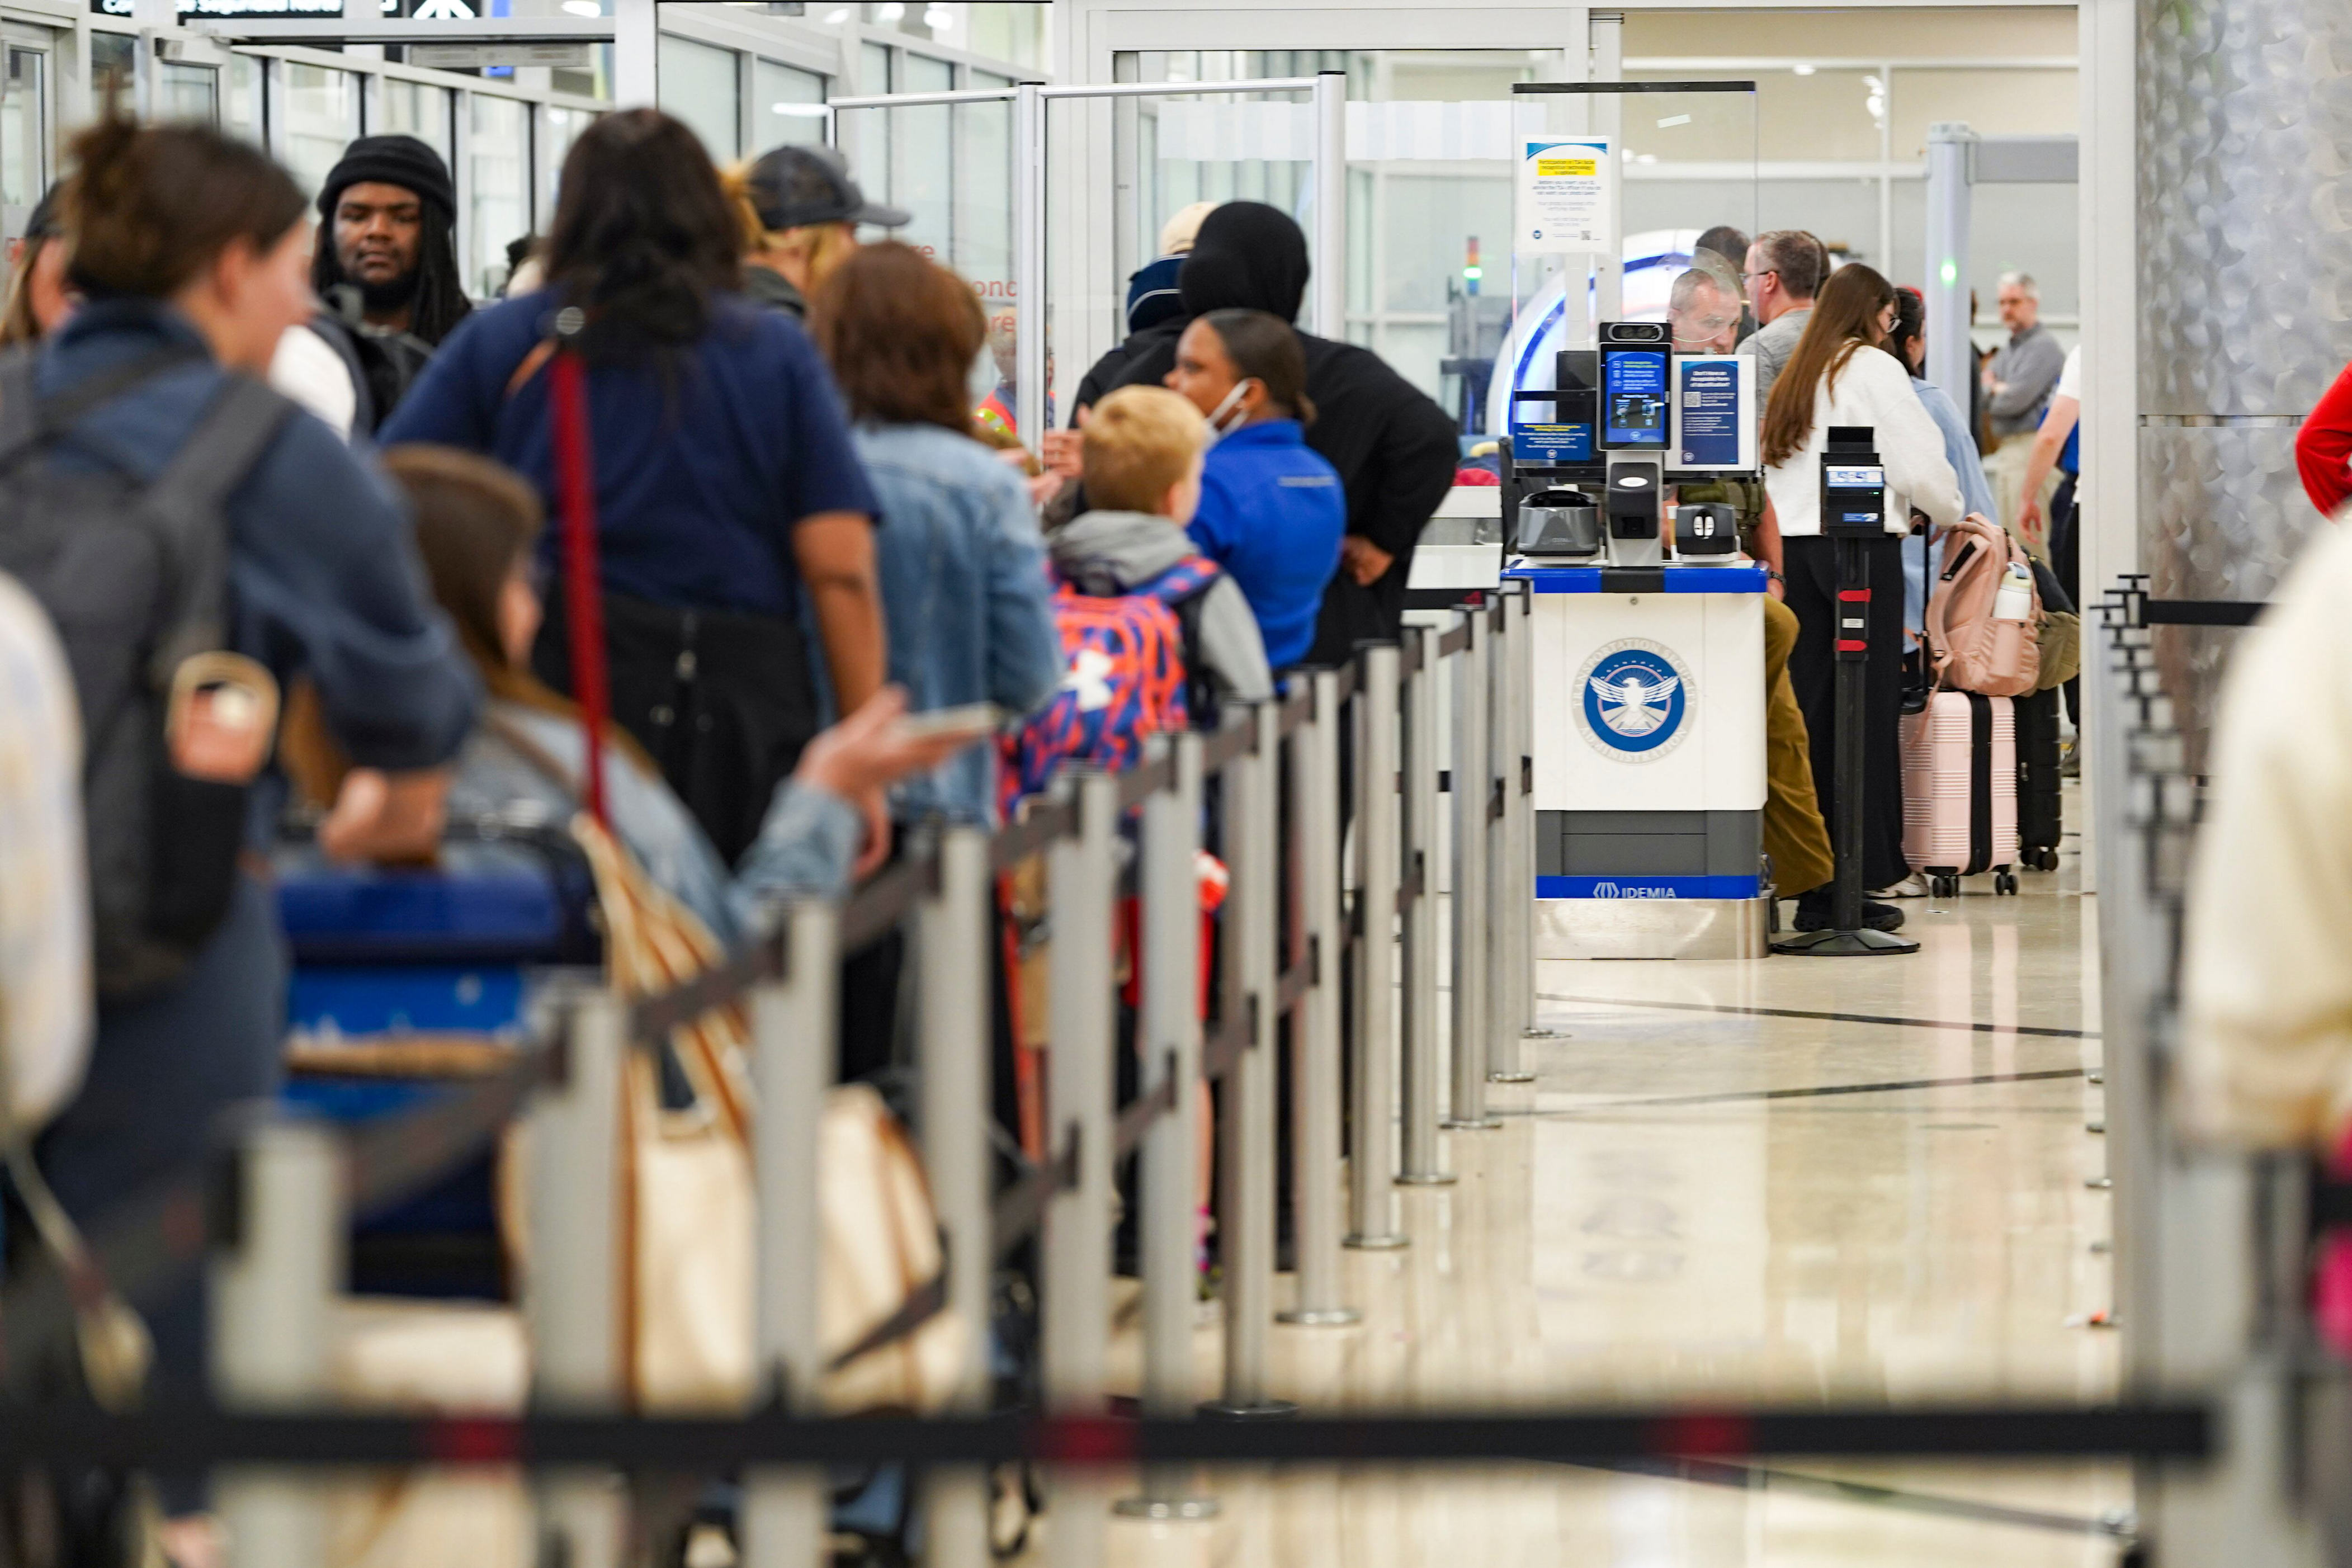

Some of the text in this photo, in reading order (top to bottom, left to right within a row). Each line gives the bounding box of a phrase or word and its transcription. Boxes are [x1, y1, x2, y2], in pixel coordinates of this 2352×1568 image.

[1573, 639, 1697, 707] TRANSPORTATION SECURITY
[1580, 726, 1688, 762] ADMINISTRATION
[1622, 887, 1676, 899] IDEMIA
